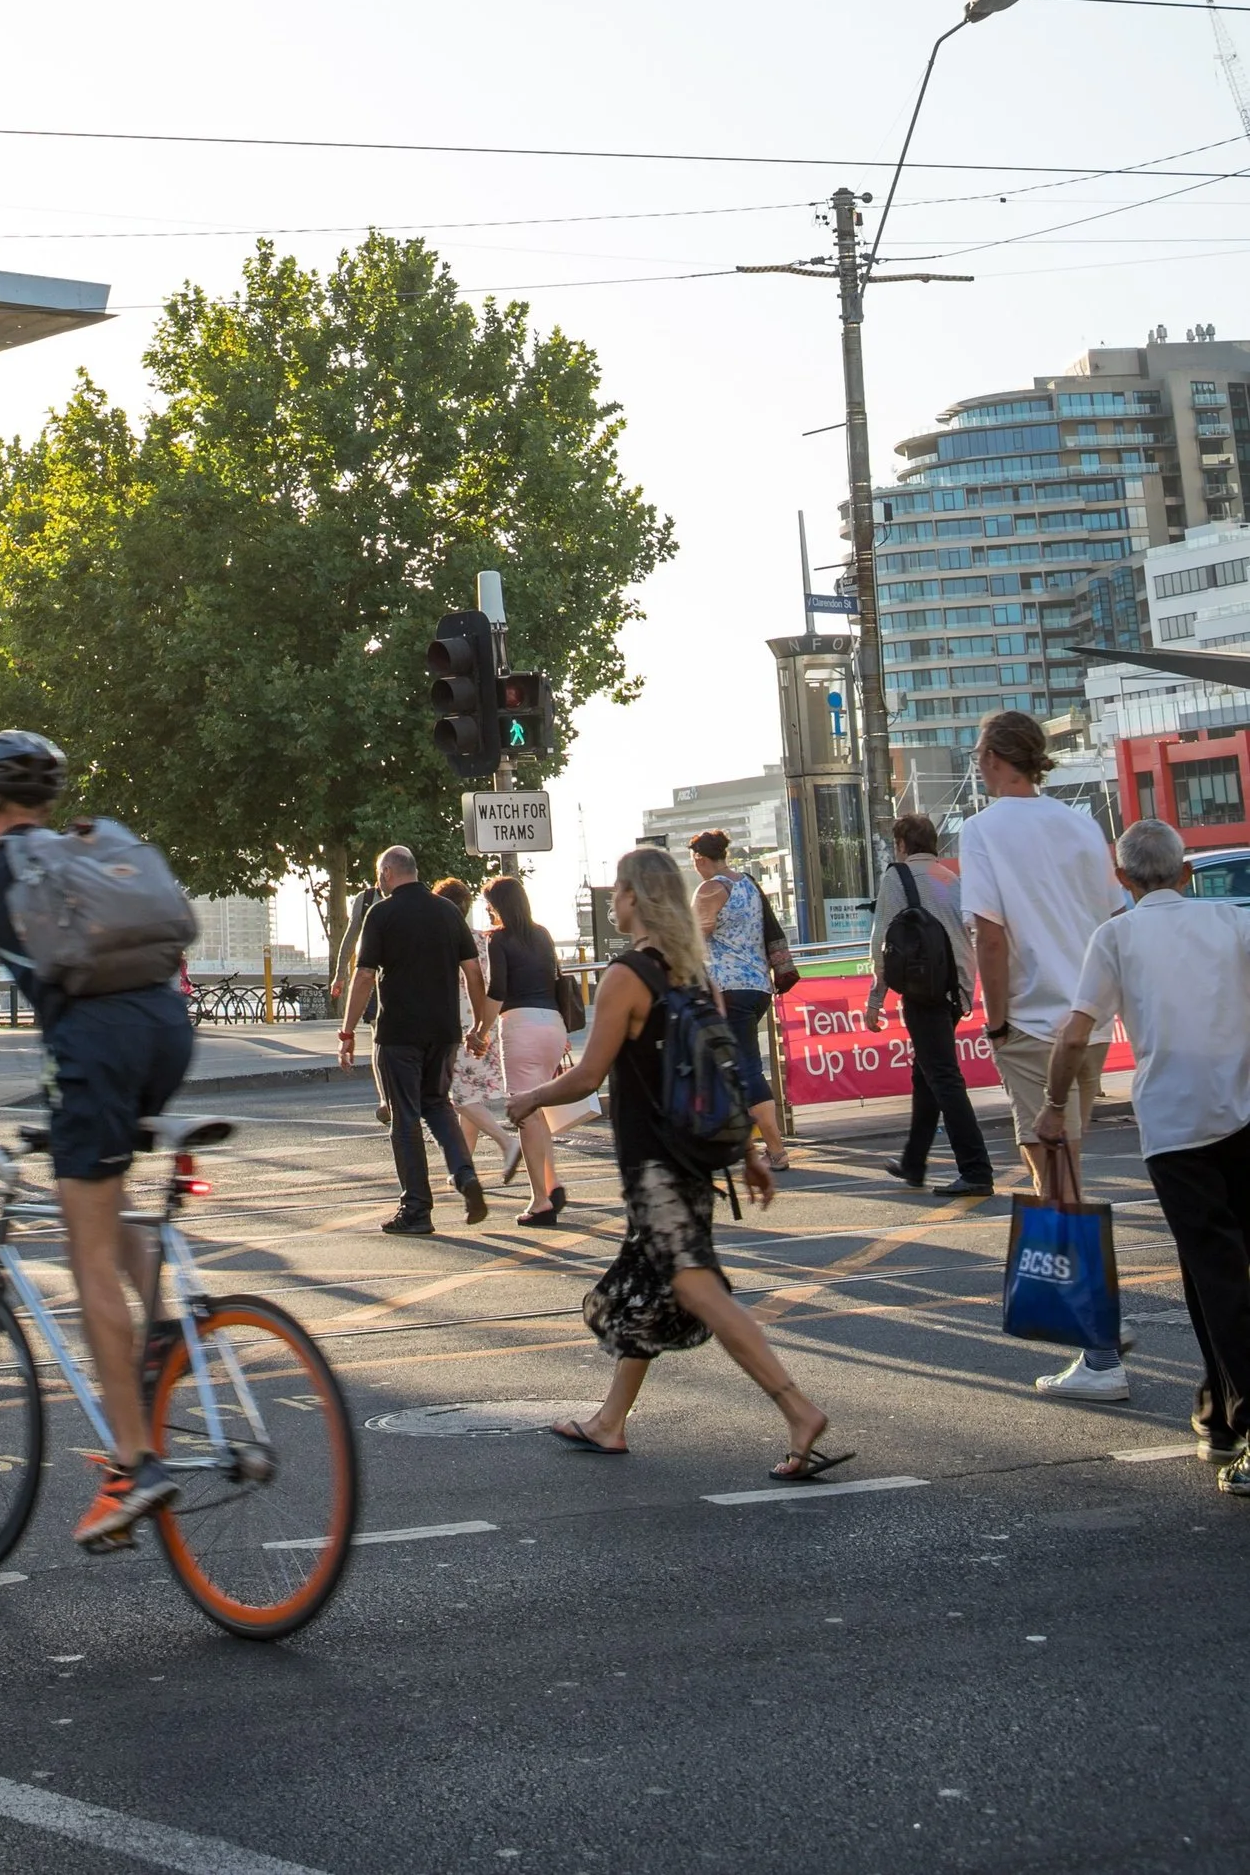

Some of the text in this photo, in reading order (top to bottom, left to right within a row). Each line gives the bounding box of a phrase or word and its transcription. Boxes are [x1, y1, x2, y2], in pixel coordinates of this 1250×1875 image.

[812, 597, 852, 609] Clarendon St
[478, 803, 547, 820] WATCH FOR
[493, 824, 535, 841] TRAMS
[856, 962, 872, 975] PT
[795, 1002, 889, 1036] Tenns
[804, 1044, 844, 1082] Up
[852, 1043, 880, 1072] to
[1018, 1247, 1071, 1279] BCSS
